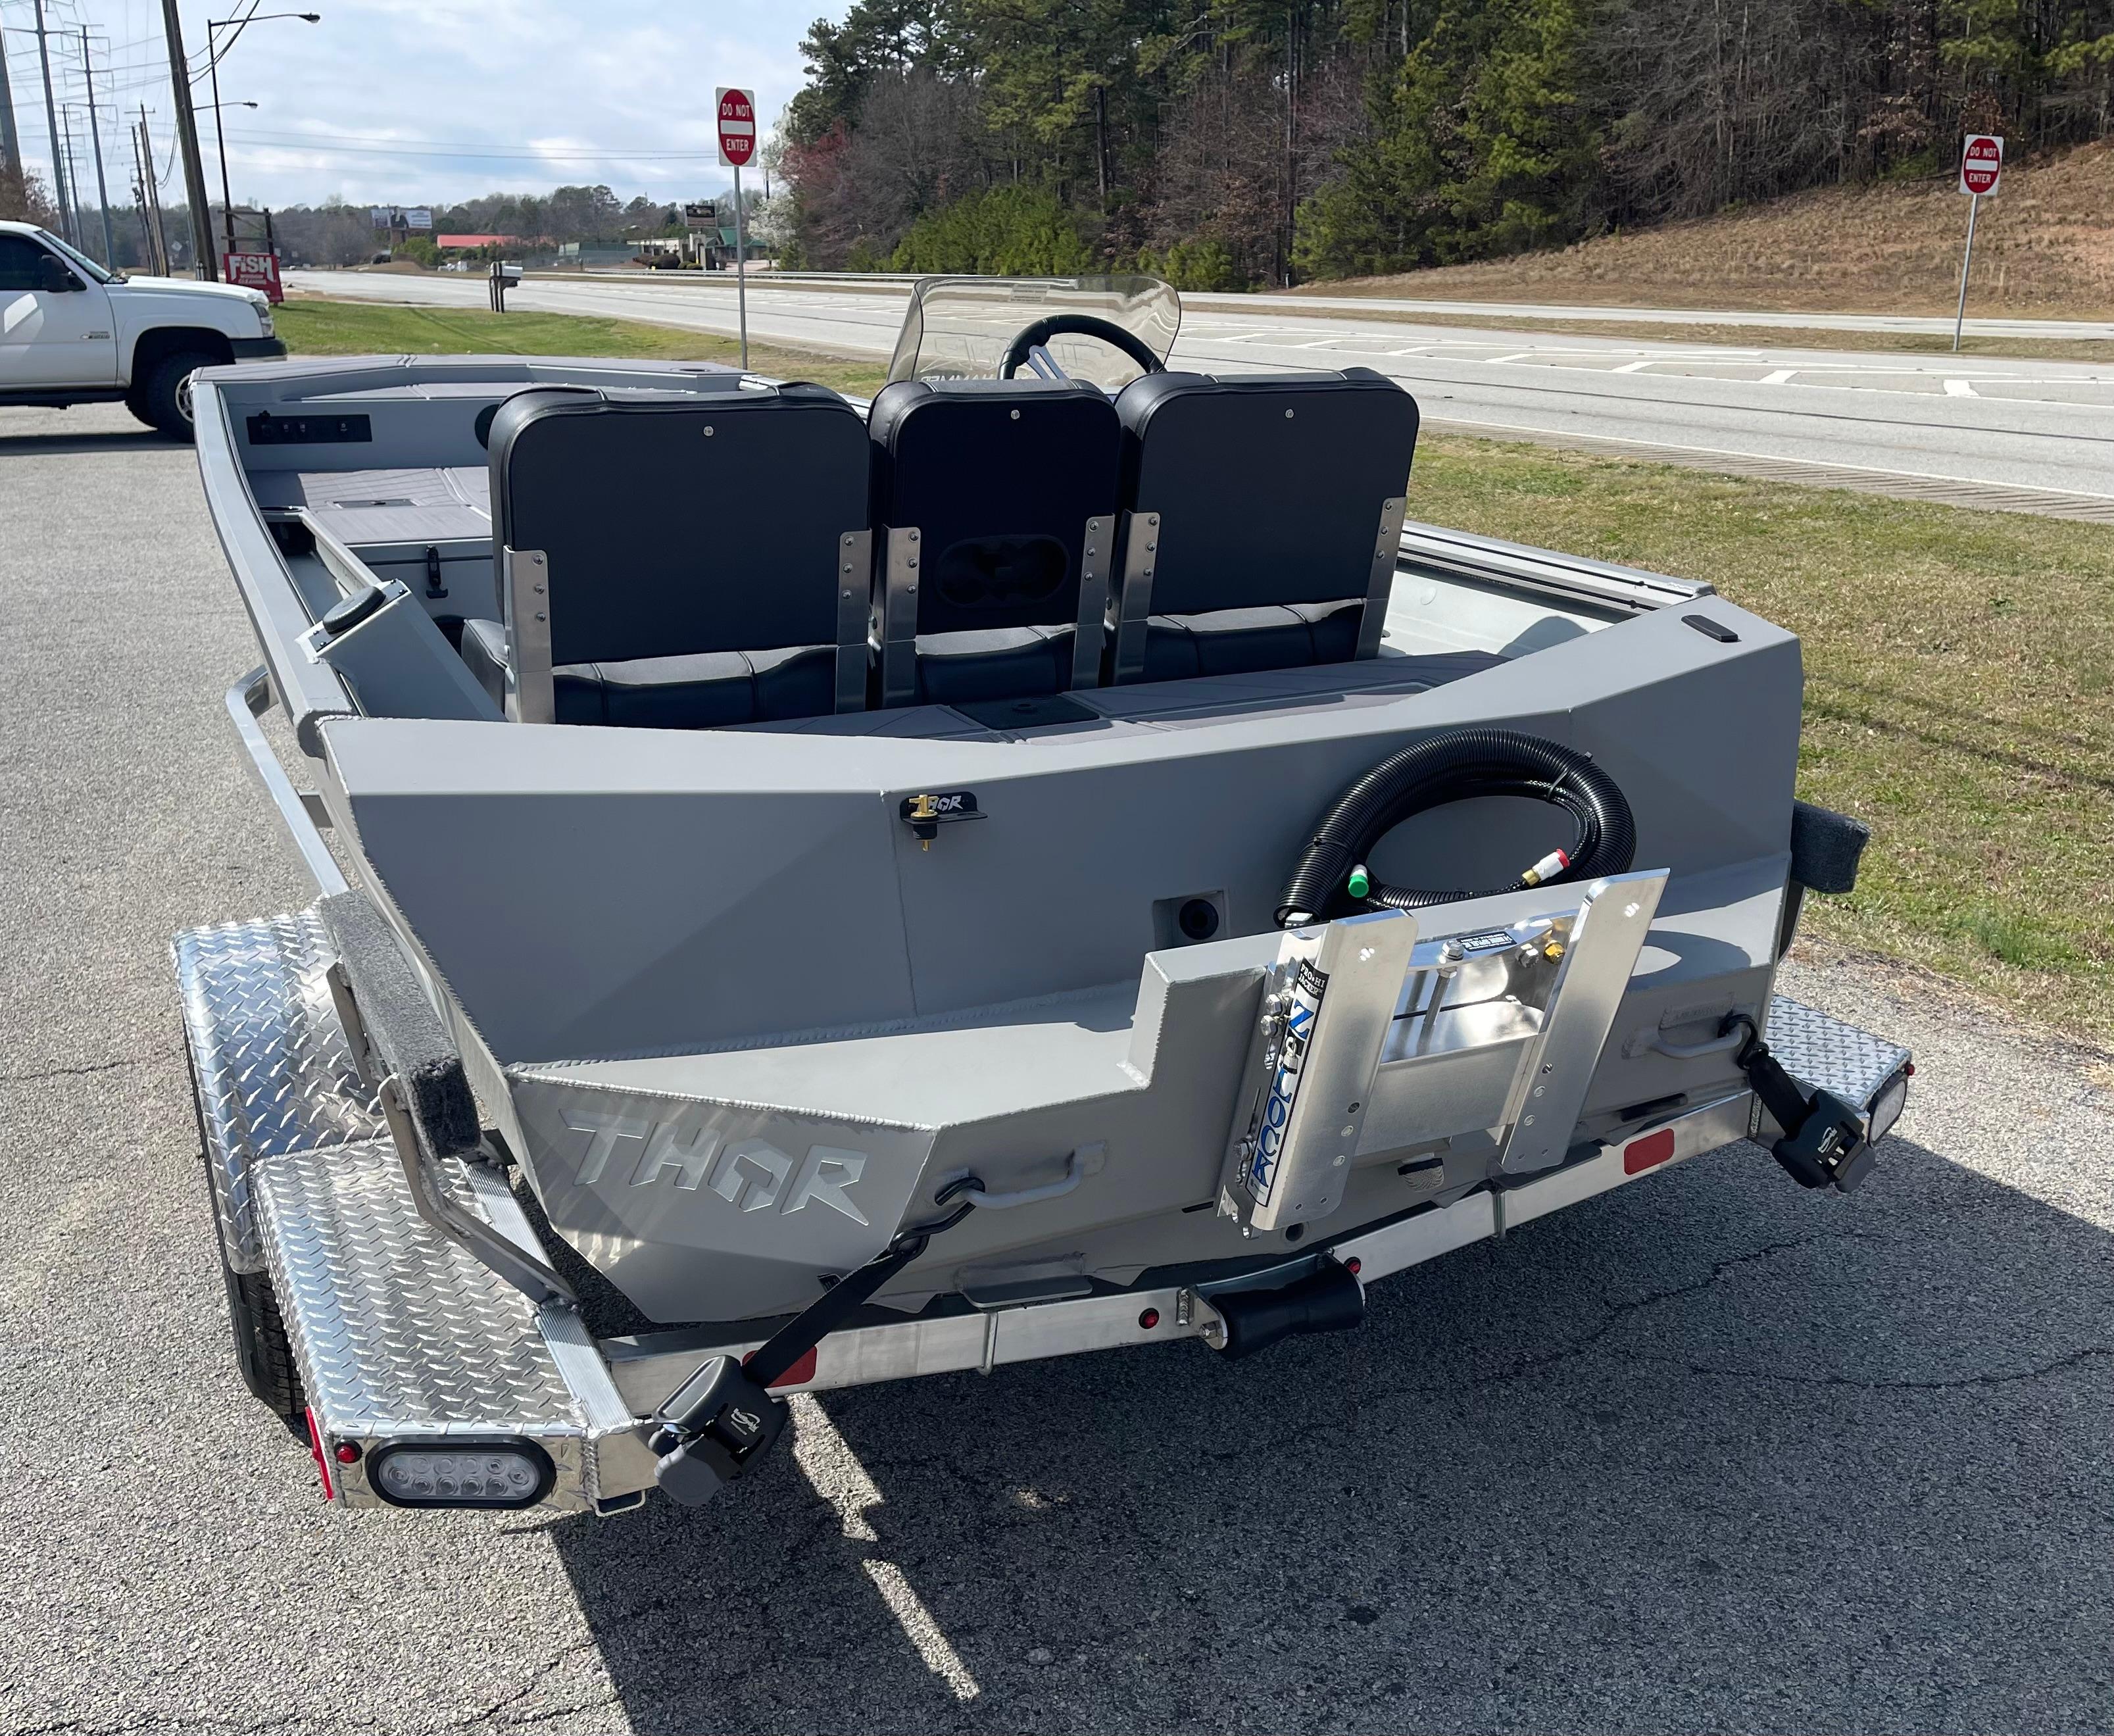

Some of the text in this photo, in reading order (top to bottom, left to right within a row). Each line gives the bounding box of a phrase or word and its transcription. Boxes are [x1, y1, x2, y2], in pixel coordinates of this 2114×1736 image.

[722, 103, 750, 117] DO NOT
[726, 138, 749, 151] ENTER
[1970, 146, 1997, 158] DO NOT
[1969, 172, 1991, 184] ENTER
[559, 1109, 869, 1226] THOR
